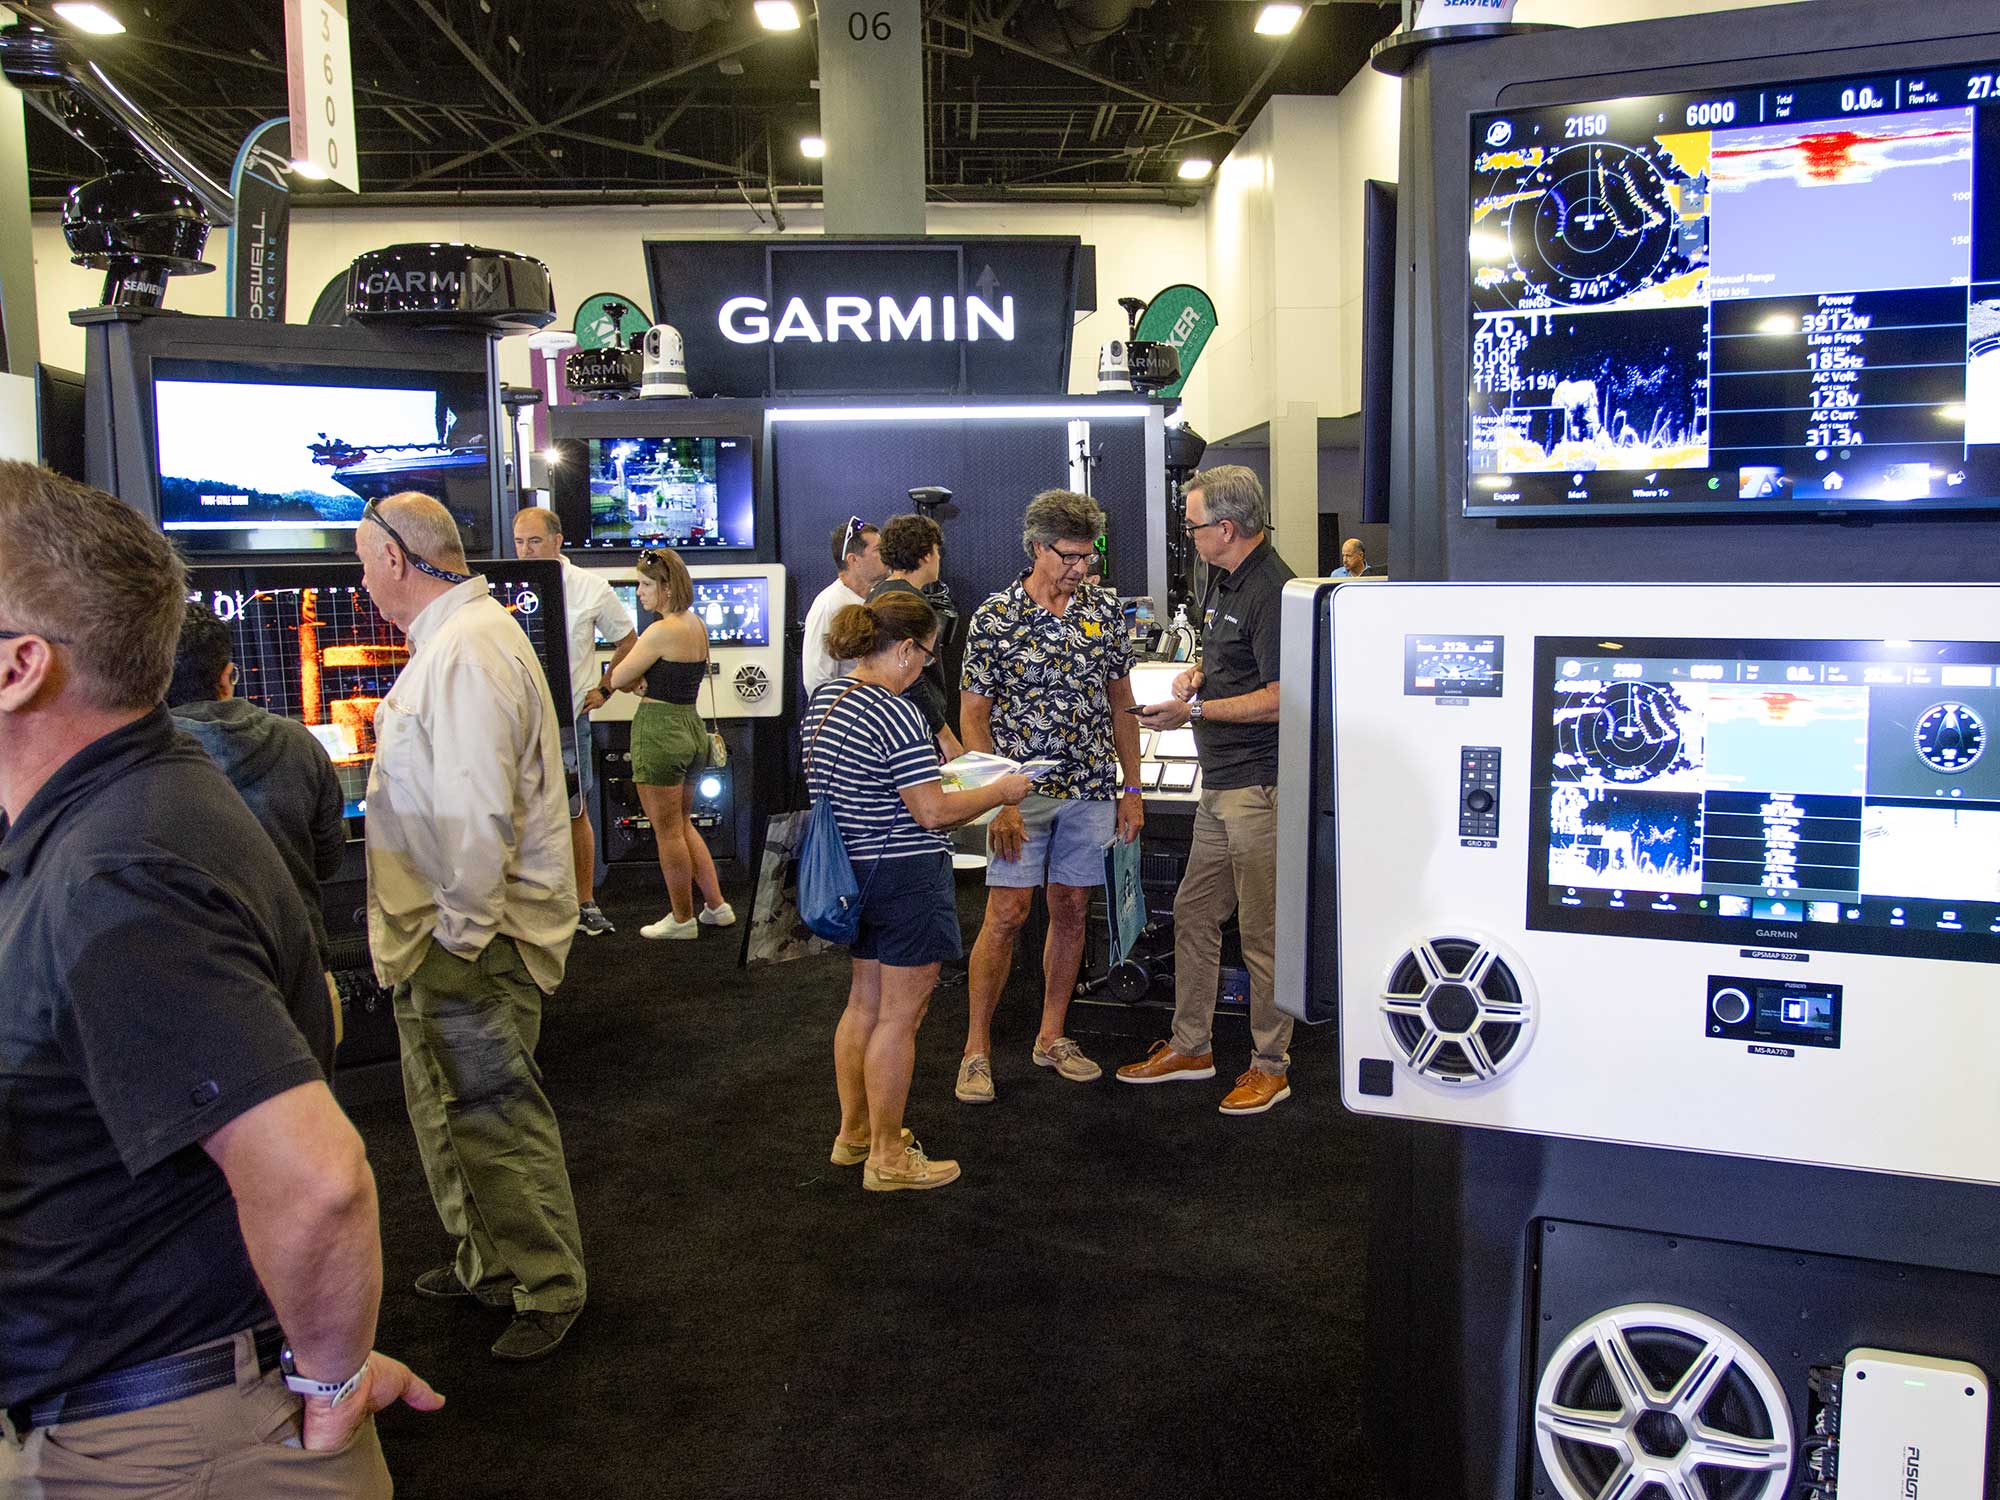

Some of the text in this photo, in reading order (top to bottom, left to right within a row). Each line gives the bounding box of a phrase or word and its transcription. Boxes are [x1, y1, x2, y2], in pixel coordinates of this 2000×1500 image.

[848, 12, 892, 41] 06
[321, 8, 338, 169] 3600
[1909, 81, 1924, 92] Fuel
[1776, 95, 1793, 105] Total
[1909, 95, 1924, 105] Flow
[1686, 102, 1735, 126] 6000
[1776, 107, 1790, 117] Fuel
[1565, 114, 1607, 138] 2150
[250, 209, 266, 320] OSWELL
[267, 236, 277, 317] MARINE
[123, 280, 164, 296] SEAVIEW
[368, 271, 493, 294] GARMIN
[1519, 296, 1552, 310] RINGS
[1818, 295, 1855, 306] Power
[718, 295, 1015, 344] GARMIN
[1164, 306, 1201, 347] KER
[1807, 334, 1833, 345] Line
[1128, 358, 1170, 368] ARMIN
[1811, 372, 1830, 383] AC
[1810, 411, 1829, 421] AC
[1568, 489, 1587, 499] Mark
[1632, 488, 1657, 498] Where
[1756, 929, 1798, 939] GARMIN
[1752, 951, 1797, 960] GPSMAP 9227
[1754, 1047, 1788, 1056] MS-RA770
